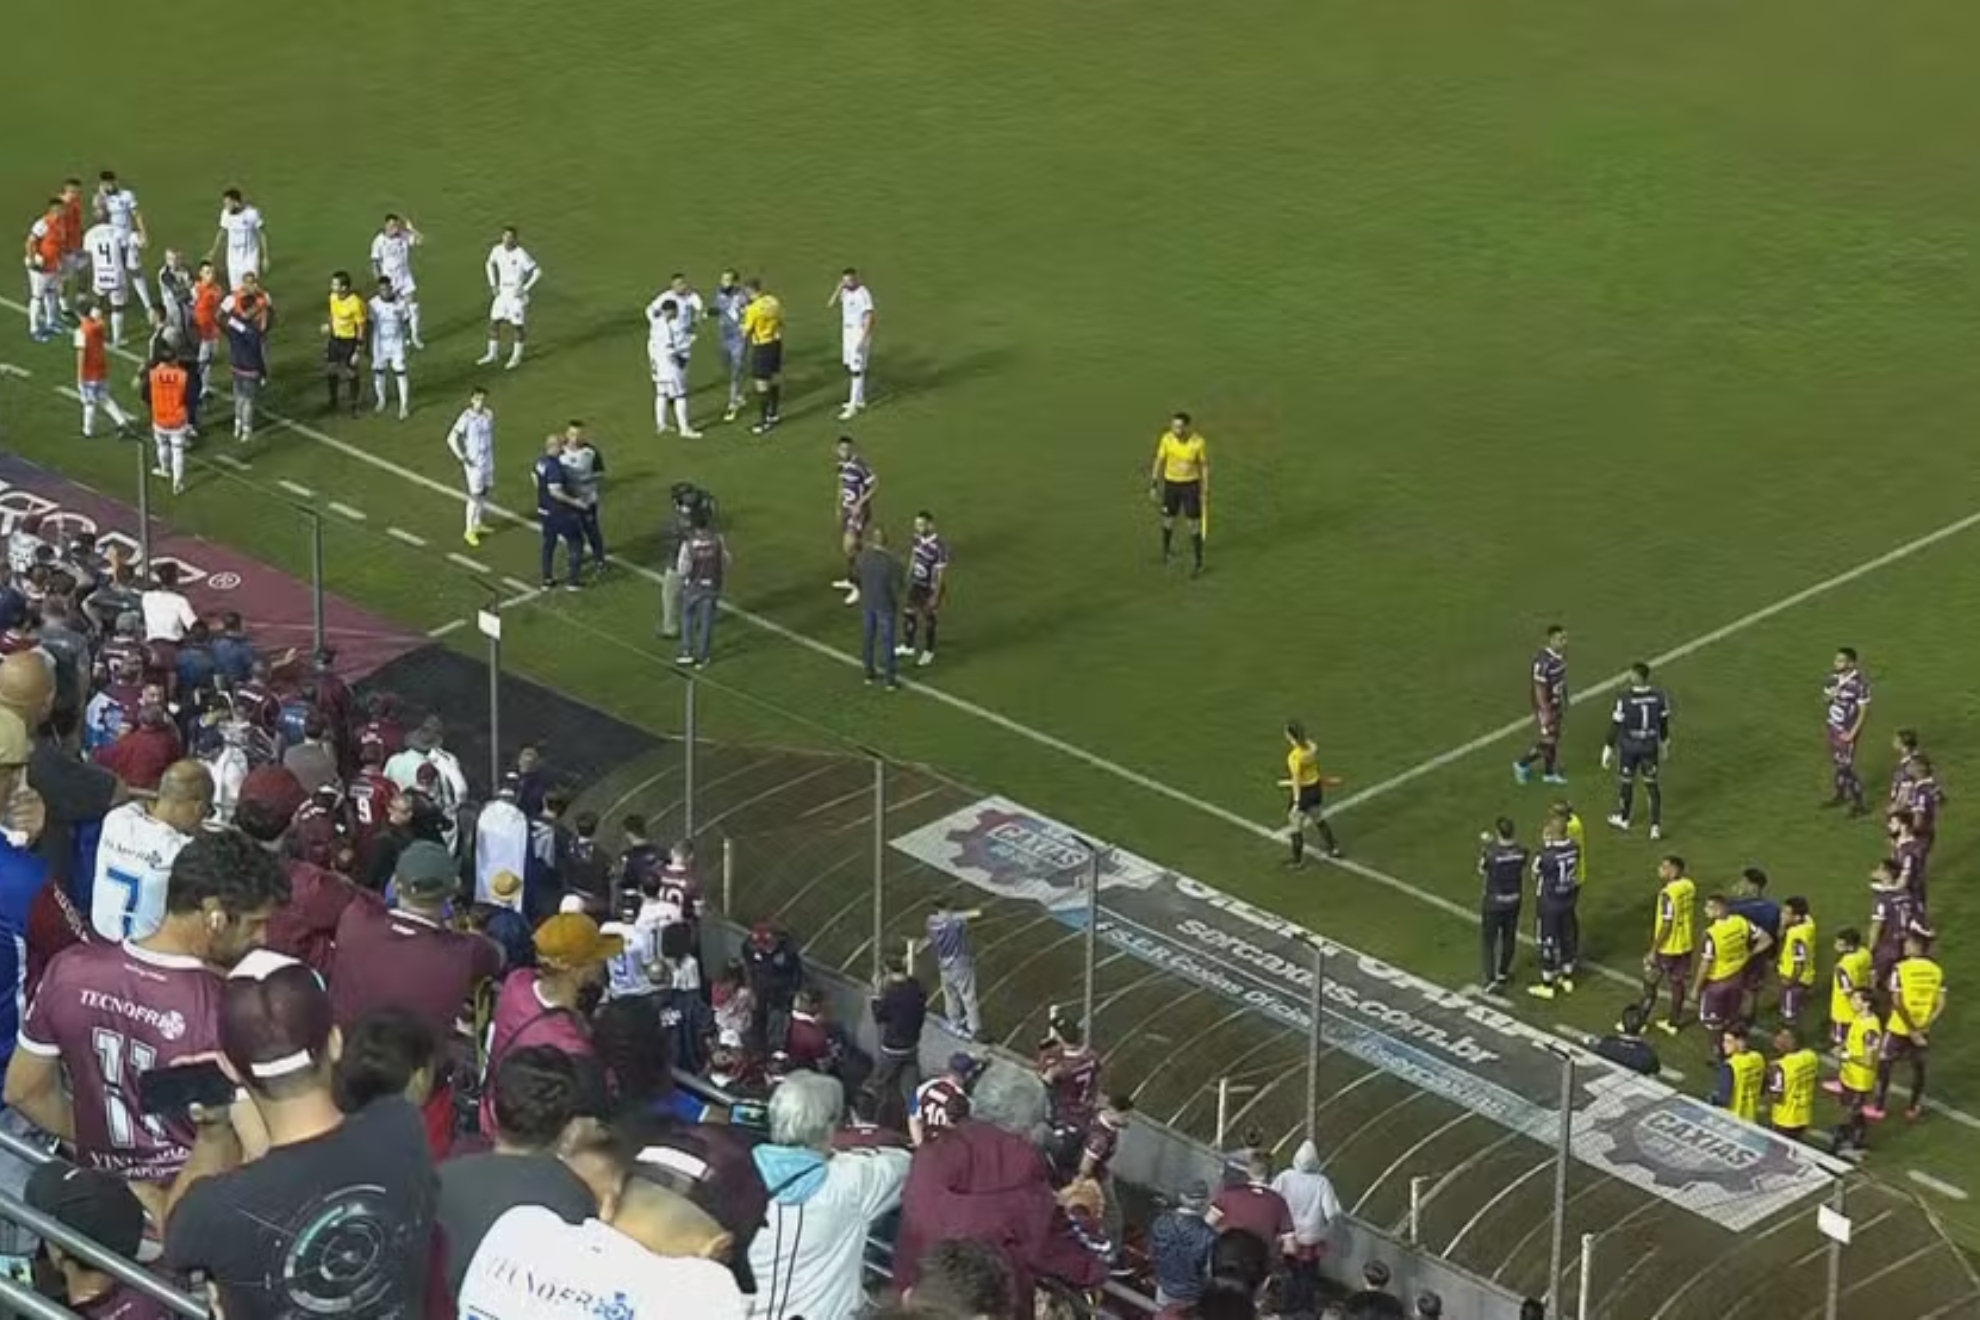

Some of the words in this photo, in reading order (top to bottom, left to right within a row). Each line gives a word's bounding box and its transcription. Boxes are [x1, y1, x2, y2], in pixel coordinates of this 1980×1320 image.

[98, 242, 112, 265] 4
[357, 796, 373, 823] 9
[106, 866, 139, 940] 7
[1648, 1111, 1758, 1166] CAXIAS
